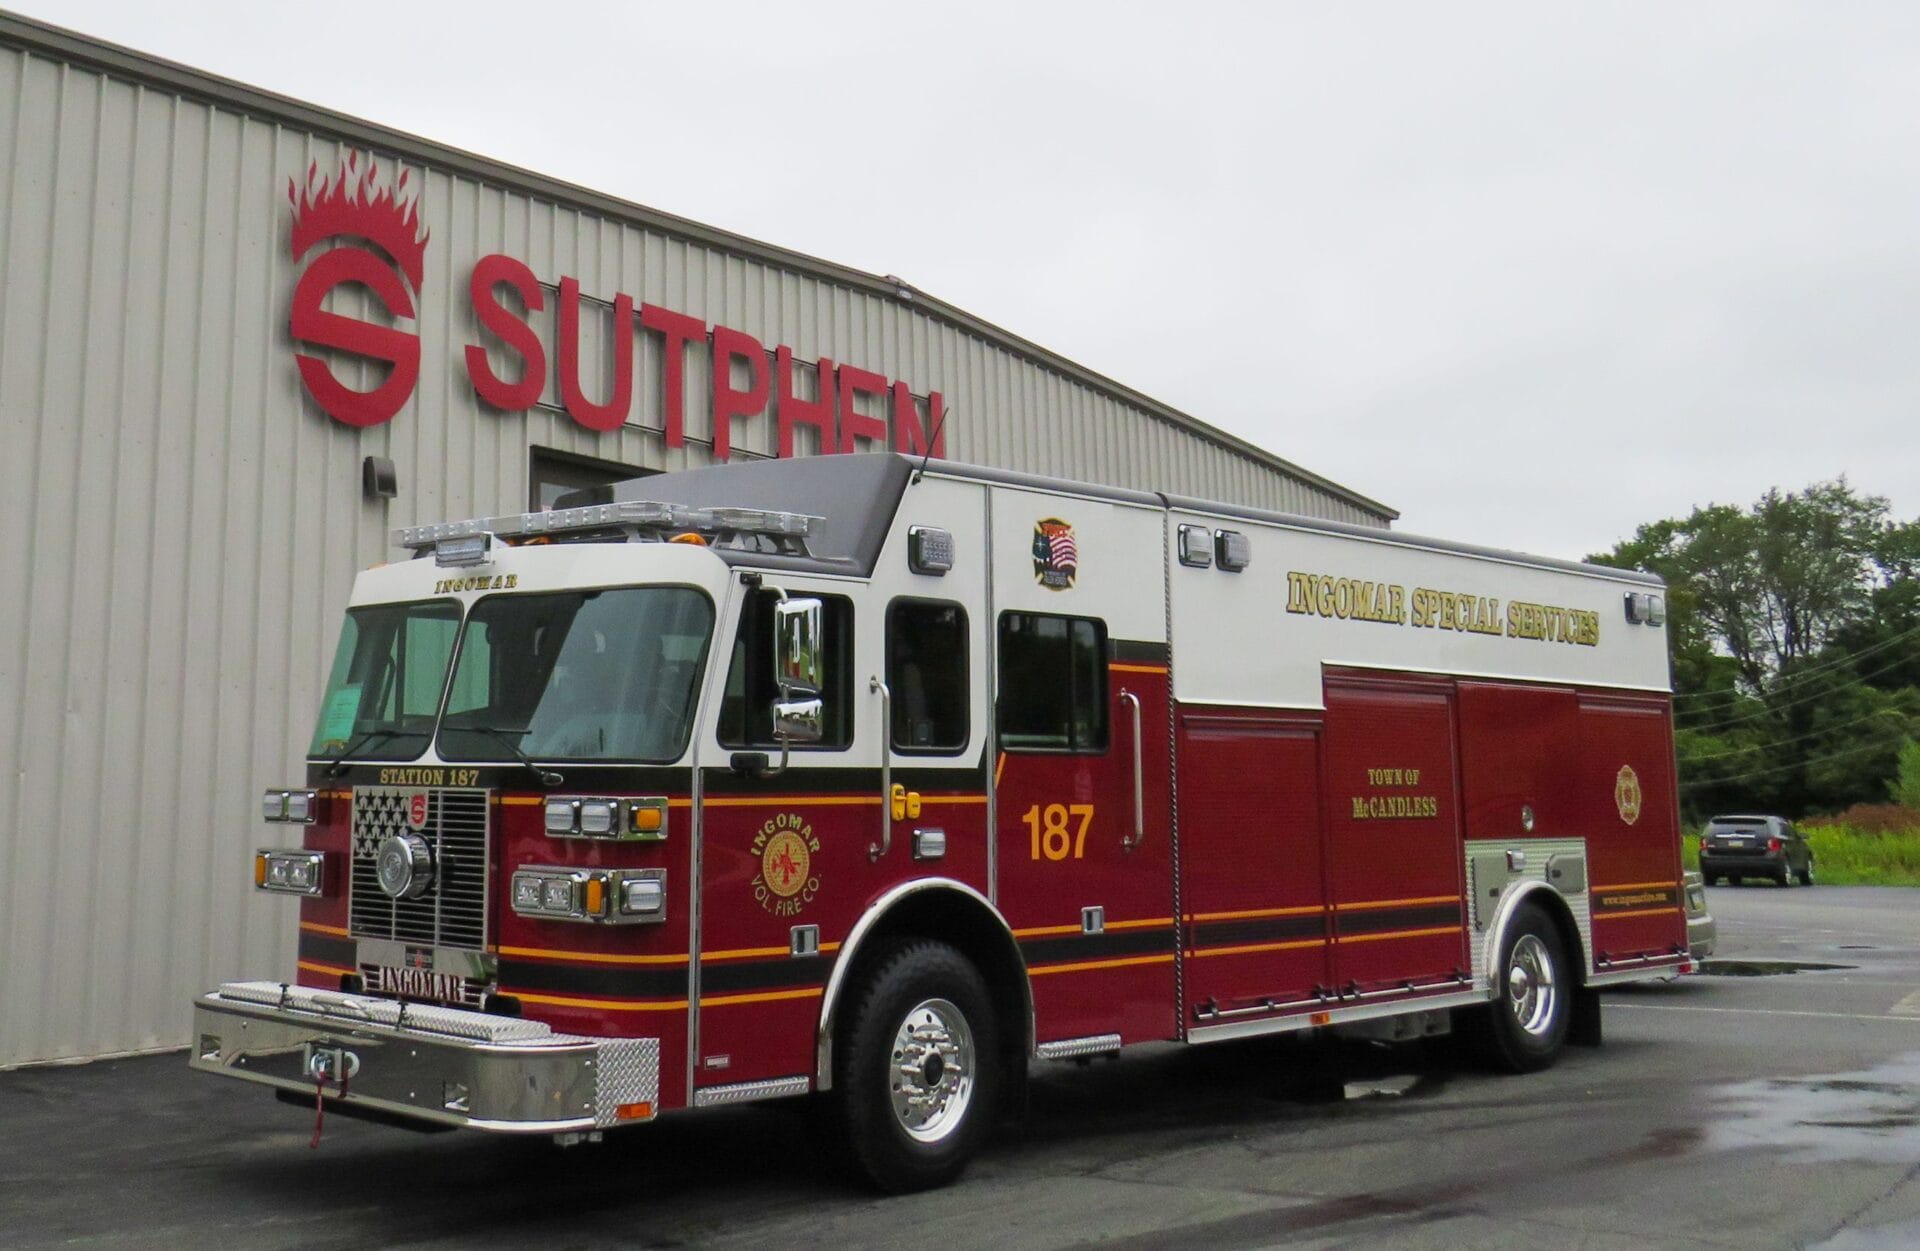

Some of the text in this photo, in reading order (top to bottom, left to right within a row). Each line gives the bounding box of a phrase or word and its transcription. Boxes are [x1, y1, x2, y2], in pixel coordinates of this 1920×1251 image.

[465, 254, 945, 460] SUTPHEN
[434, 574, 518, 594] INGOMAR
[1286, 571, 1600, 647] INGOMAR SPECIAL SERVICES
[380, 768, 480, 786] STATION 187
[1367, 768, 1420, 786] TOWN OF
[1351, 796, 1437, 819] McCANDLESS
[750, 813, 821, 856] INGOMAR
[1022, 803, 1094, 860] 187
[751, 873, 823, 917] VOL. FIRE CO.
[380, 966, 464, 1002] INGOMAR
